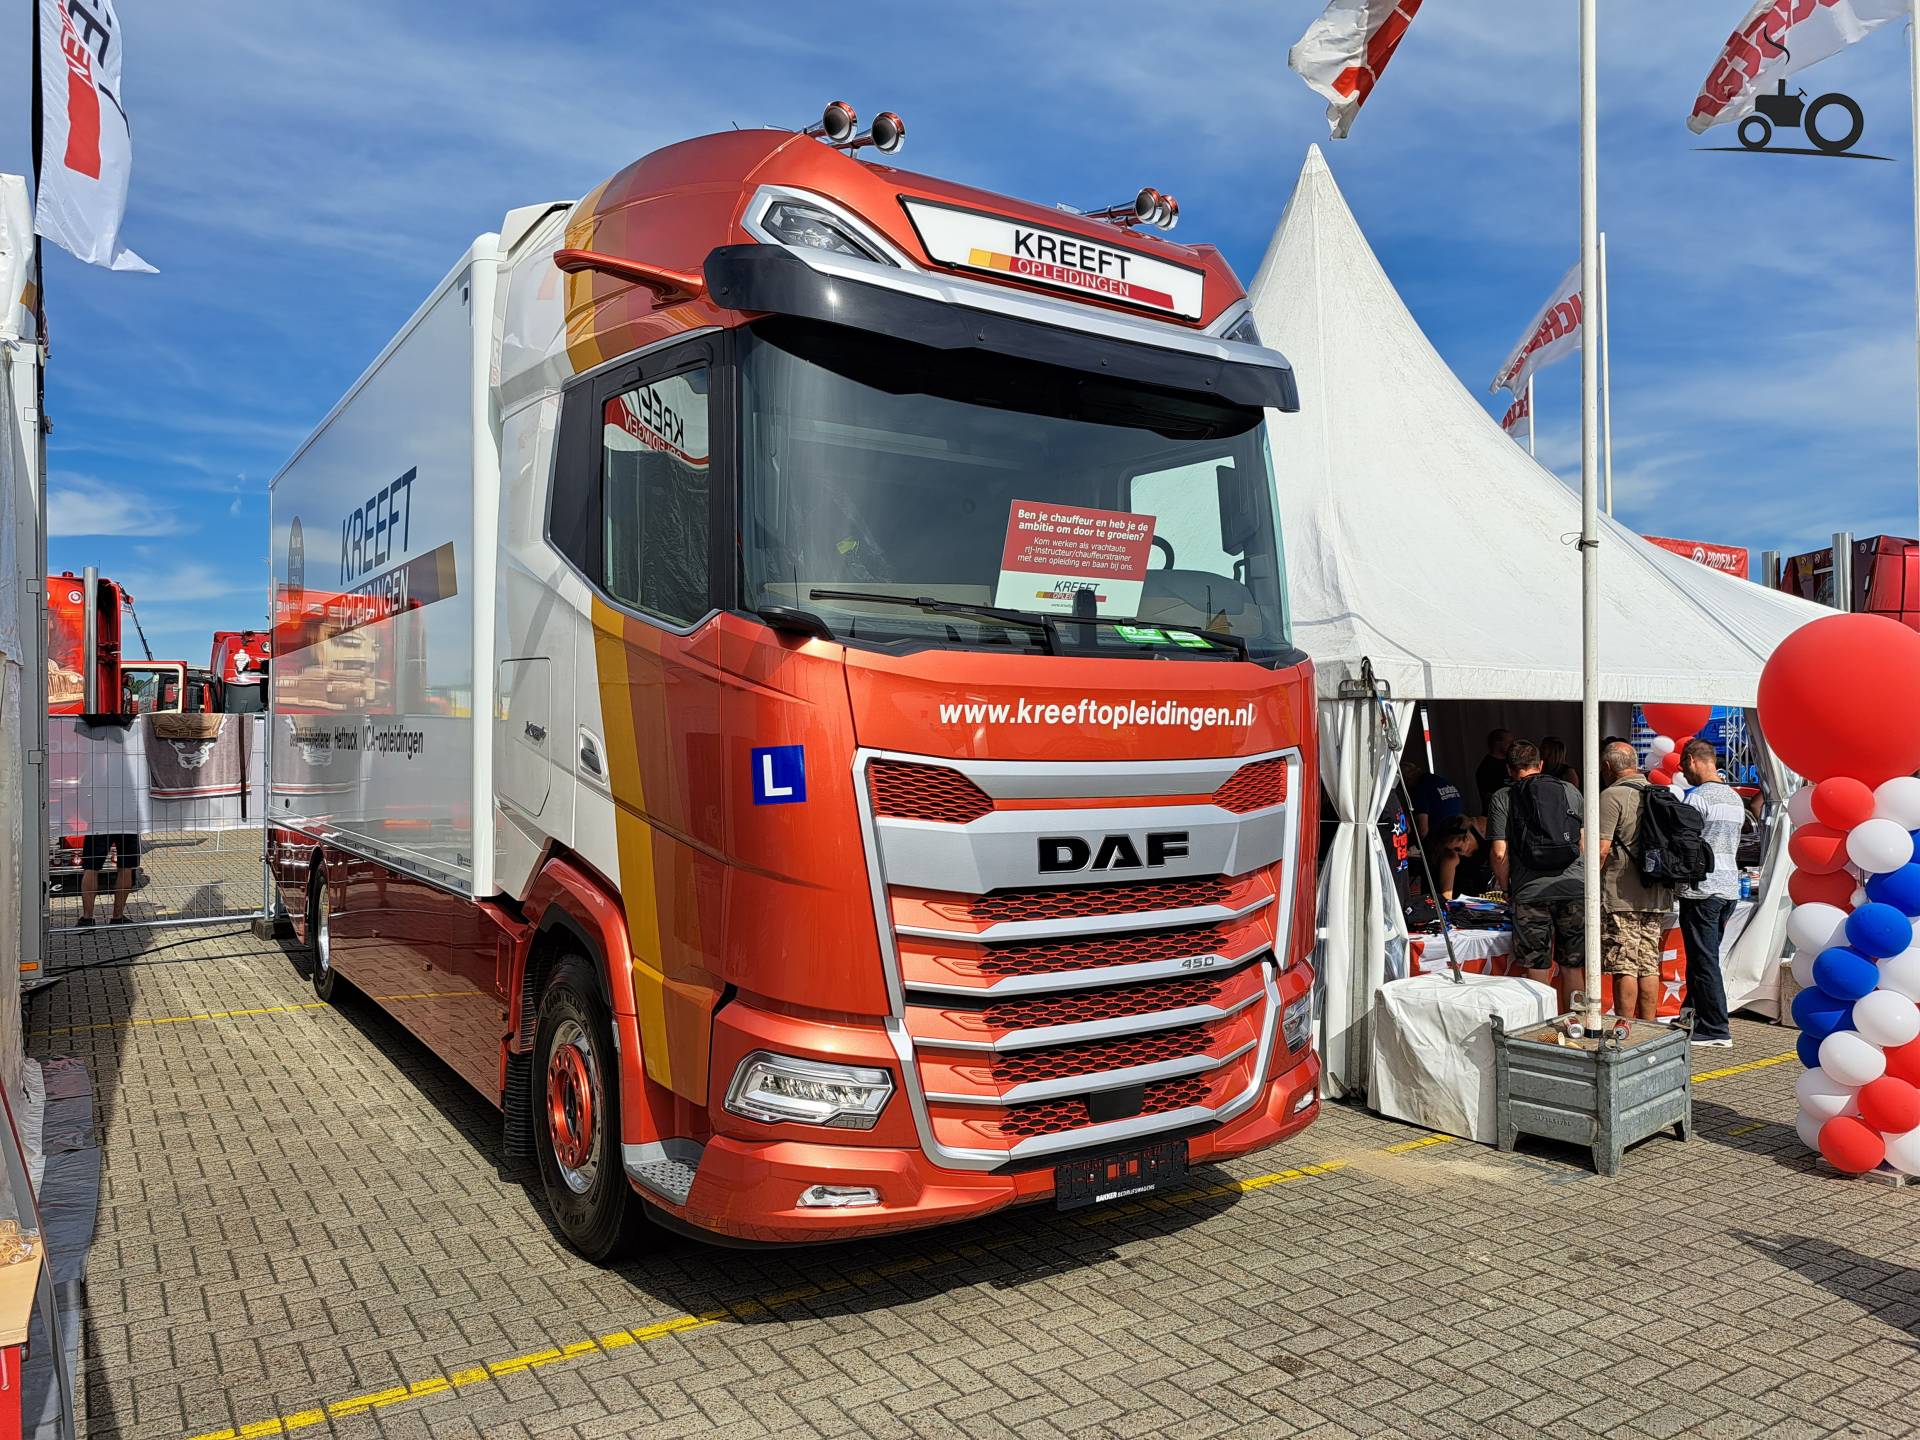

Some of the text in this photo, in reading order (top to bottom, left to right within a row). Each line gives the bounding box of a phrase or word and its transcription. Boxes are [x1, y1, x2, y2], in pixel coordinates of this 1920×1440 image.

[1014, 229, 1131, 280] KREEFT
[1017, 255, 1130, 297] OPLEIDINGEN
[340, 465, 417, 587] KREEFT
[1018, 509, 1149, 532] Ben je chauffeur en heb je de
[1018, 521, 1144, 541] ambitie om door te groeien?
[1034, 536, 1126, 553] Kom werken als vrachtauto
[1705, 551, 1737, 570] PROFILE
[1017, 554, 1032, 562] met
[1034, 555, 1047, 563] een
[1049, 556, 1080, 568] opleiding
[1092, 561, 1109, 569] baan
[1110, 562, 1119, 571] bij
[1120, 563, 1134, 571] ons.
[340, 566, 409, 632] OPLEIDINGEN
[938, 698, 1254, 731] www.kreeftopleidingen.nl
[334, 725, 358, 750] Heftruck
[362, 724, 424, 760] VCA-opleidingen
[762, 754, 793, 797] L
[1037, 831, 1190, 875] DAF
[1181, 956, 1215, 969] 450
